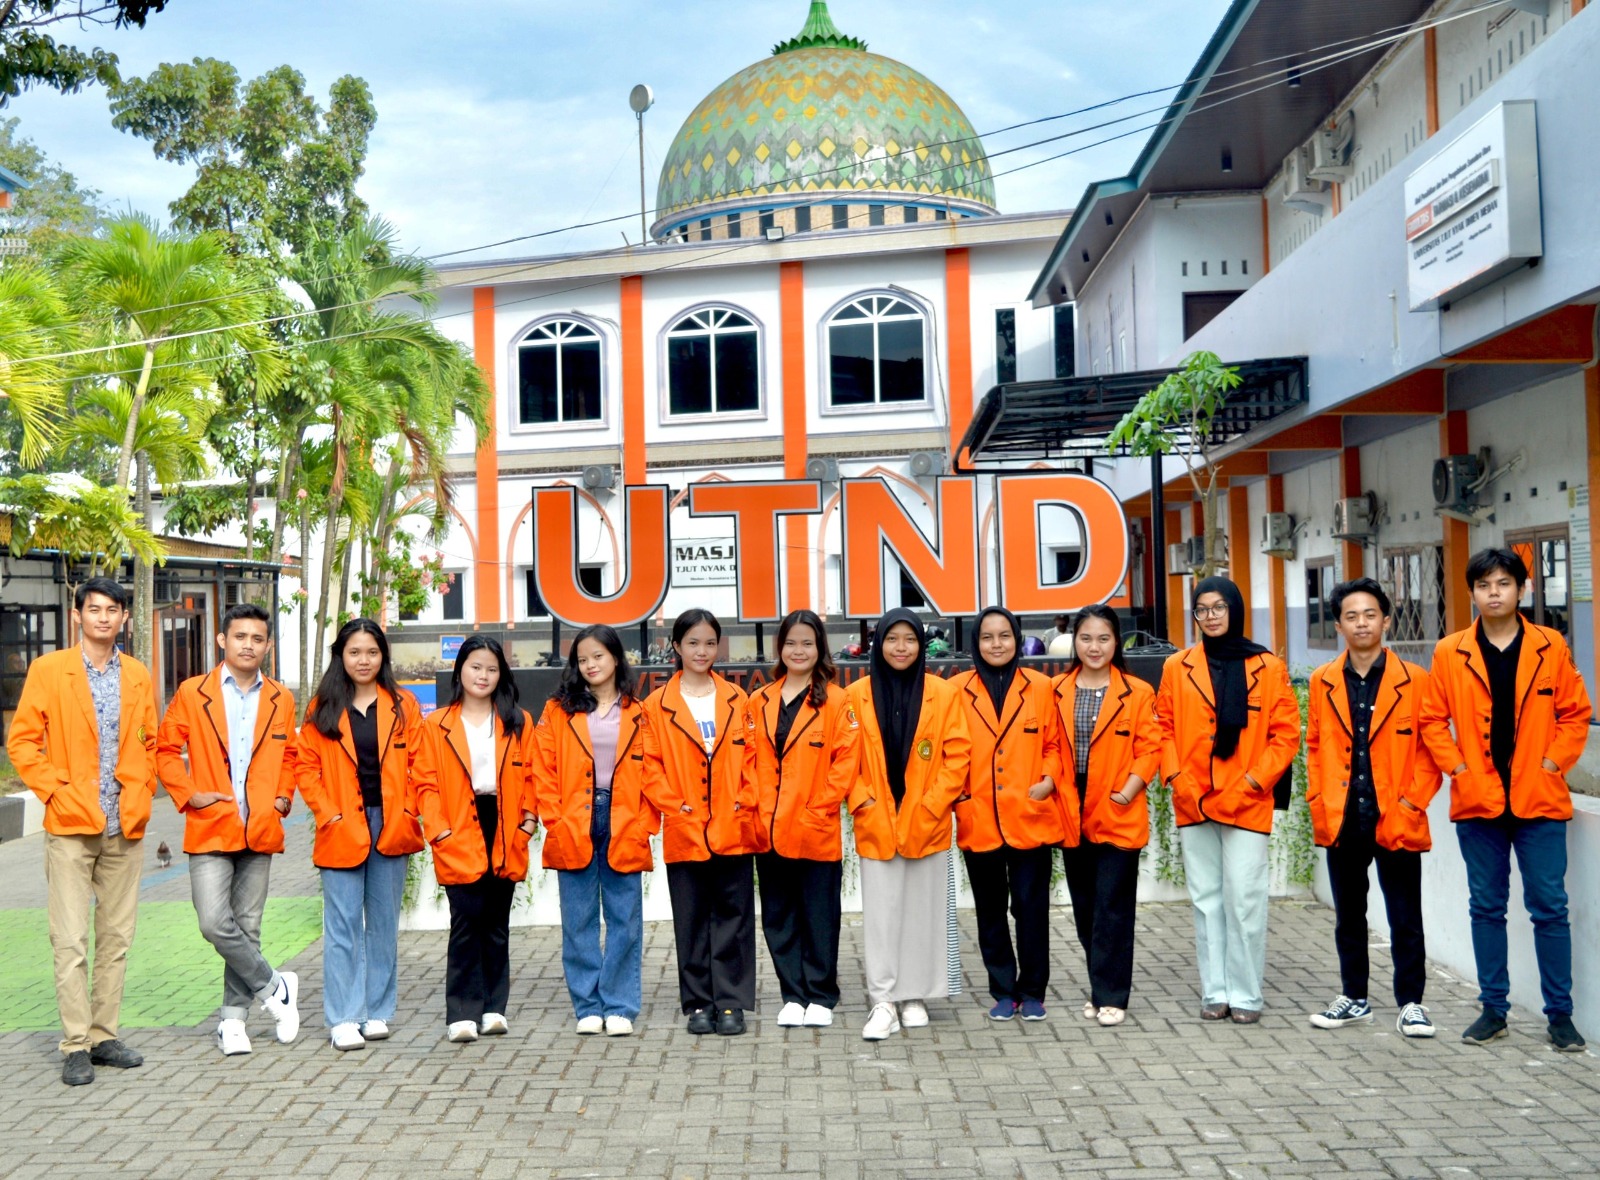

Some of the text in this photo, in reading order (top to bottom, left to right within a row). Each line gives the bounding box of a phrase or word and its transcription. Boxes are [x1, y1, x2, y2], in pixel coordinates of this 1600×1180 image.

[532, 473, 1128, 628] UTND
[676, 545, 735, 561] MASJ
[675, 565, 698, 573] TJUT
[700, 564, 727, 573] NYAK
